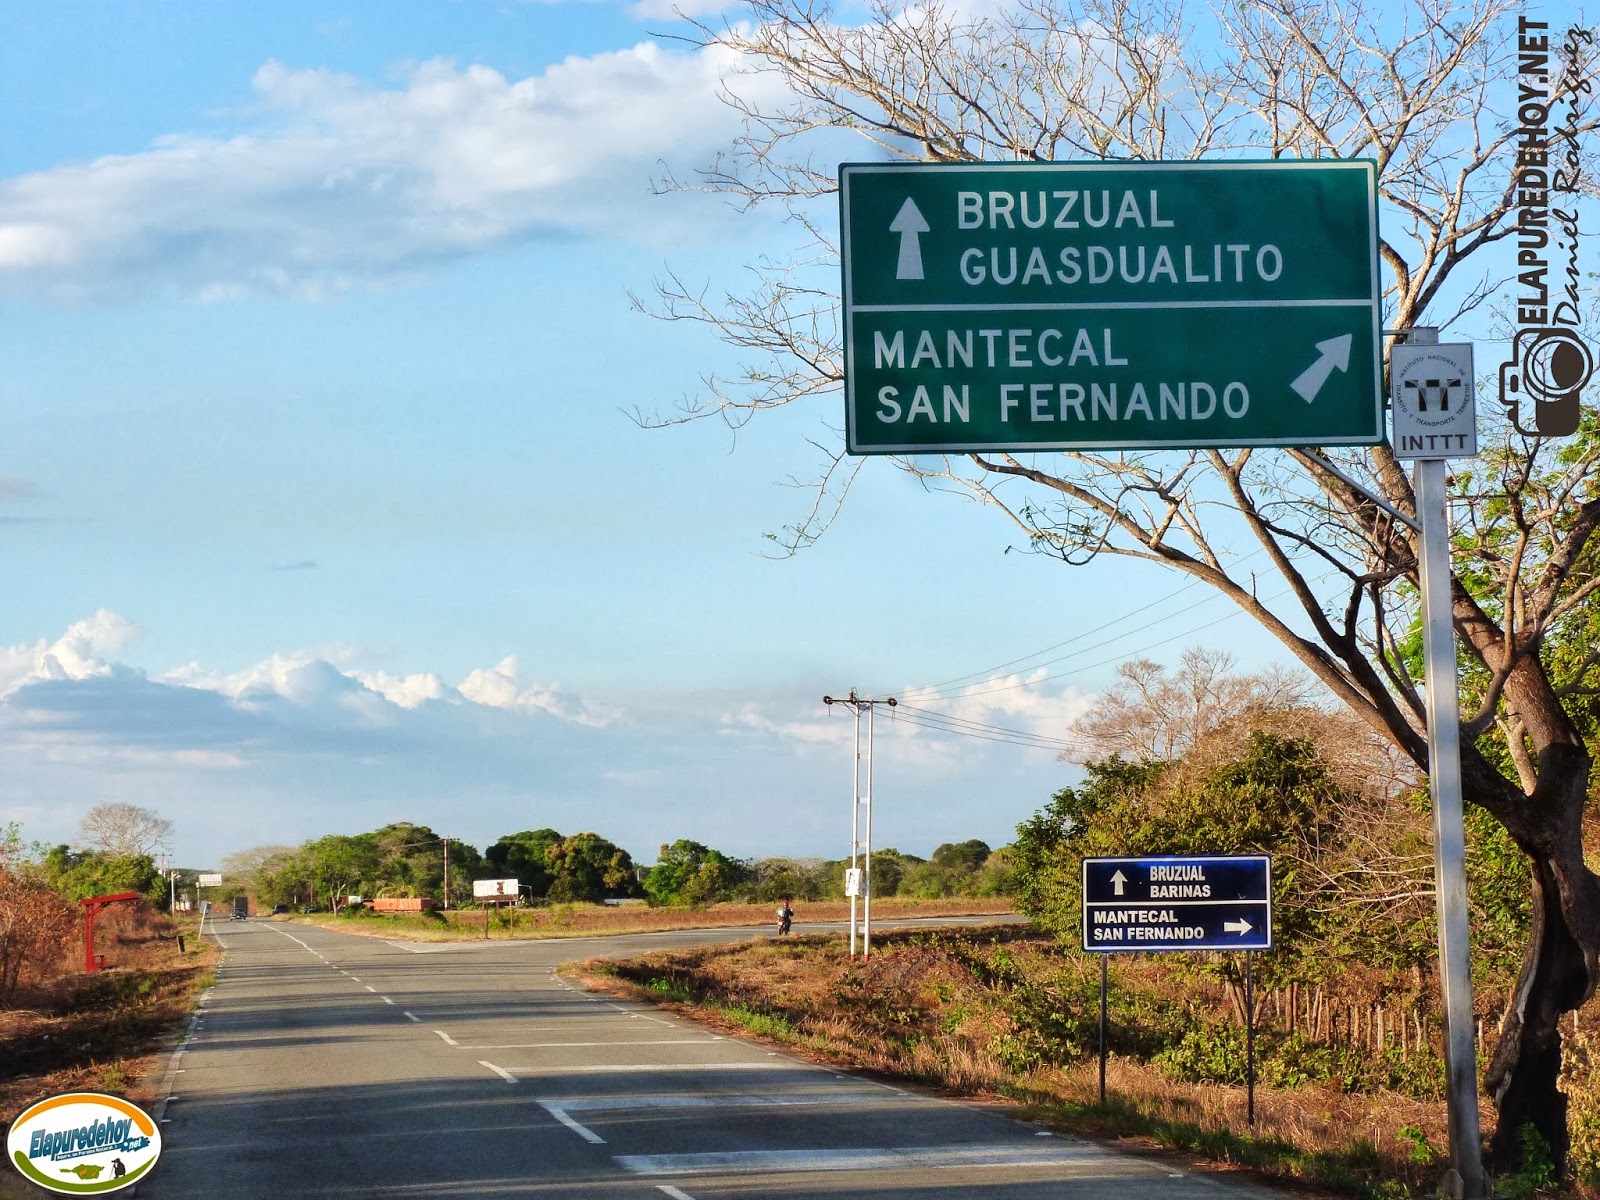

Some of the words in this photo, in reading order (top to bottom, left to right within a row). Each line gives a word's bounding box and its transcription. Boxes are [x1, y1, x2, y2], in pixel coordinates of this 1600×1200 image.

[957, 189, 1175, 230] BRUZUAL
[959, 243, 1283, 286] GUASDUALITO
[873, 328, 1129, 369] MANTECAL
[1399, 356, 1425, 379] INSTITUTO
[1427, 354, 1458, 368] NACIONAL
[1458, 368, 1466, 377] DE
[875, 384, 971, 424] SAN
[1000, 381, 1251, 423] FERNANDO
[1415, 415, 1456, 427] TRANSPORTE
[1455, 382, 1471, 416] TERRESTRE
[1402, 433, 1468, 451] INTTT
[1150, 865, 1206, 882] BRUZUAL
[1150, 884, 1211, 898] BARINAS
[1093, 910, 1179, 924] MANTECAL
[1093, 927, 1123, 940] SAN
[1127, 926, 1205, 940] FERNANDO
